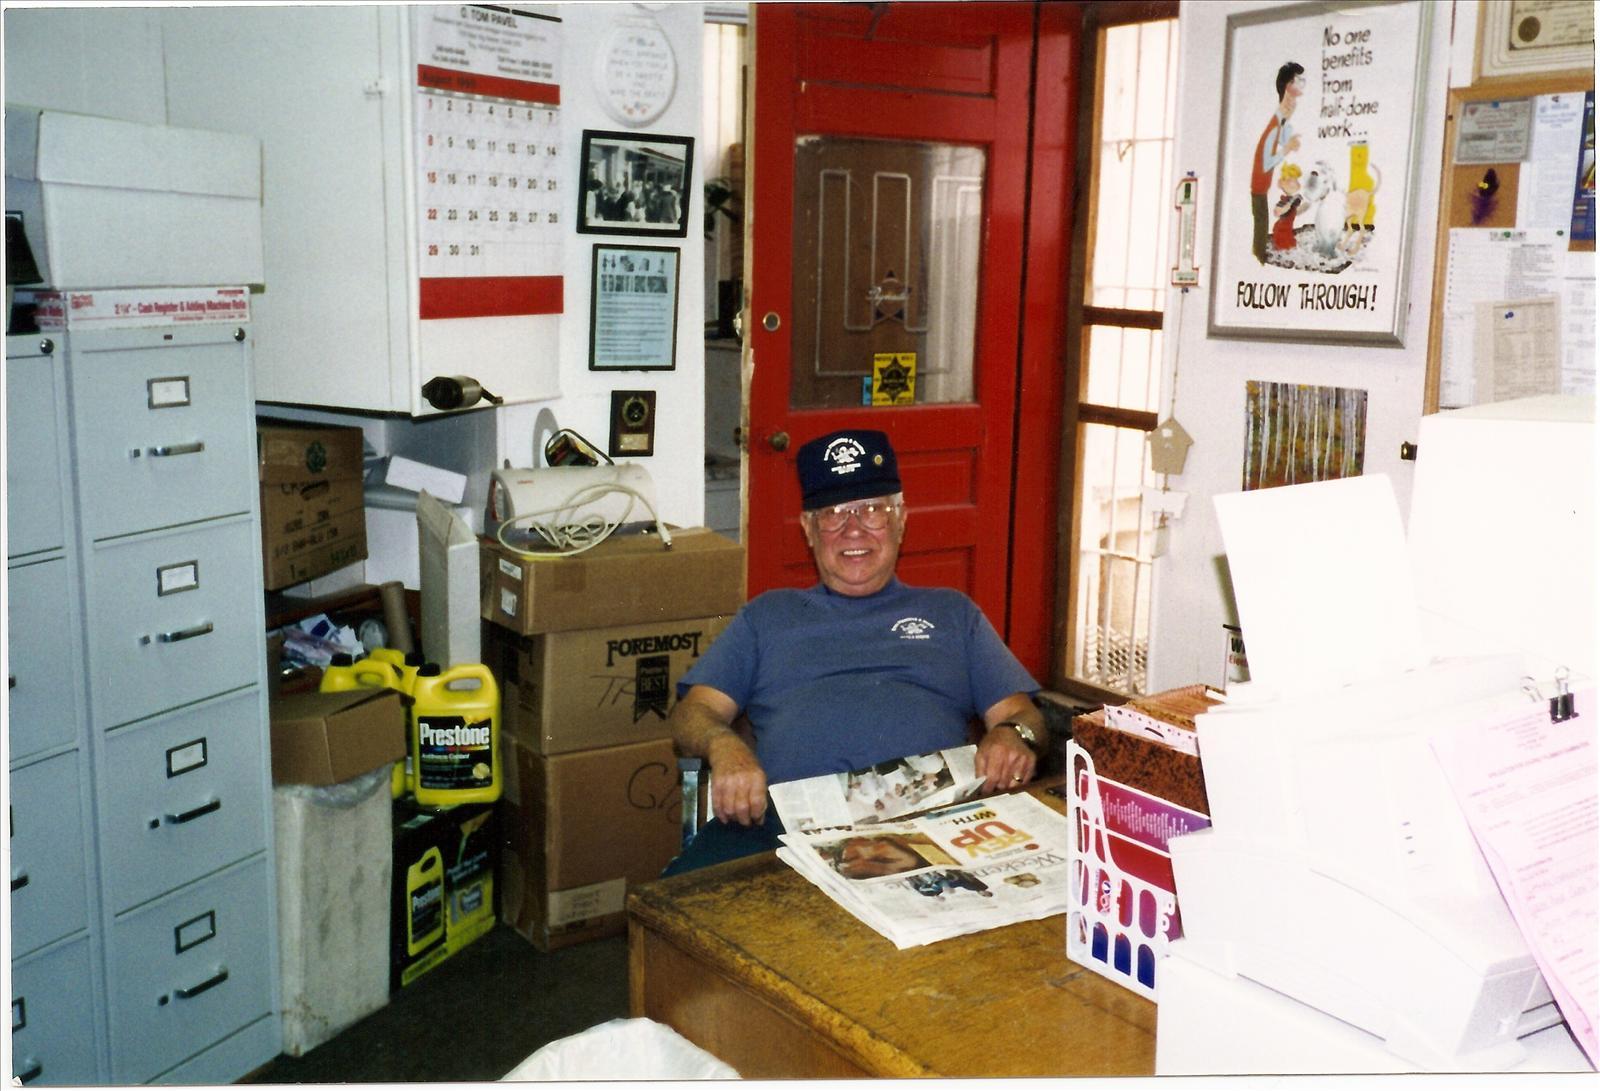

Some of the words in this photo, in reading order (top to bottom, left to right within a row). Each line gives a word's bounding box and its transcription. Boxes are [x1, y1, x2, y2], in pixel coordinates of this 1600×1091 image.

[471, 8, 489, 22] TOM
[491, 13, 518, 29] PAVEL
[1322, 26, 1341, 47] No
[1344, 28, 1371, 43] one
[1321, 47, 1373, 71] benefits
[1321, 73, 1352, 94] from
[427, 98, 433, 110] 1
[447, 99, 452, 112] 2
[467, 102, 473, 114] 3
[488, 105, 494, 115] 4
[508, 107, 513, 119] 5
[527, 109, 533, 121] 6
[548, 111, 553, 122] 7
[1320, 96, 1379, 118] half-done
[427, 134, 433, 147] 8
[447, 136, 453, 148] 9
[466, 138, 476, 151] 10
[487, 140, 496, 152] 11
[507, 142, 516, 154] 12
[526, 144, 536, 156] 13
[546, 146, 557, 156] 14
[427, 171, 437, 184] 15
[447, 173, 457, 185] 16
[467, 174, 477, 185] 17
[488, 175, 498, 188] 18
[508, 176, 518, 189] 19
[527, 178, 537, 190] 20
[547, 179, 557, 191] 21
[427, 208, 437, 221] 22
[447, 208, 458, 221] 23
[468, 209, 479, 222] 24
[488, 210, 499, 222] 25
[508, 211, 519, 223] 26
[528, 211, 538, 223] 27
[548, 212, 558, 224] 28
[428, 244, 438, 256] 29
[448, 244, 459, 256] 30
[470, 244, 480, 256] 31
[1236, 281, 1291, 309] FOLLOW
[1298, 283, 1378, 311] THROUGH!
[138, 302, 153, 314] Cash
[154, 302, 178, 315] Register
[186, 301, 206, 313] Adding
[207, 300, 231, 310] Machine
[606, 630, 703, 668] FOREMOST
[420, 723, 489, 746] Prestone
[950, 821, 1016, 848] UP
[966, 830, 1034, 858] REV
[974, 852, 1064, 878] Weeken
